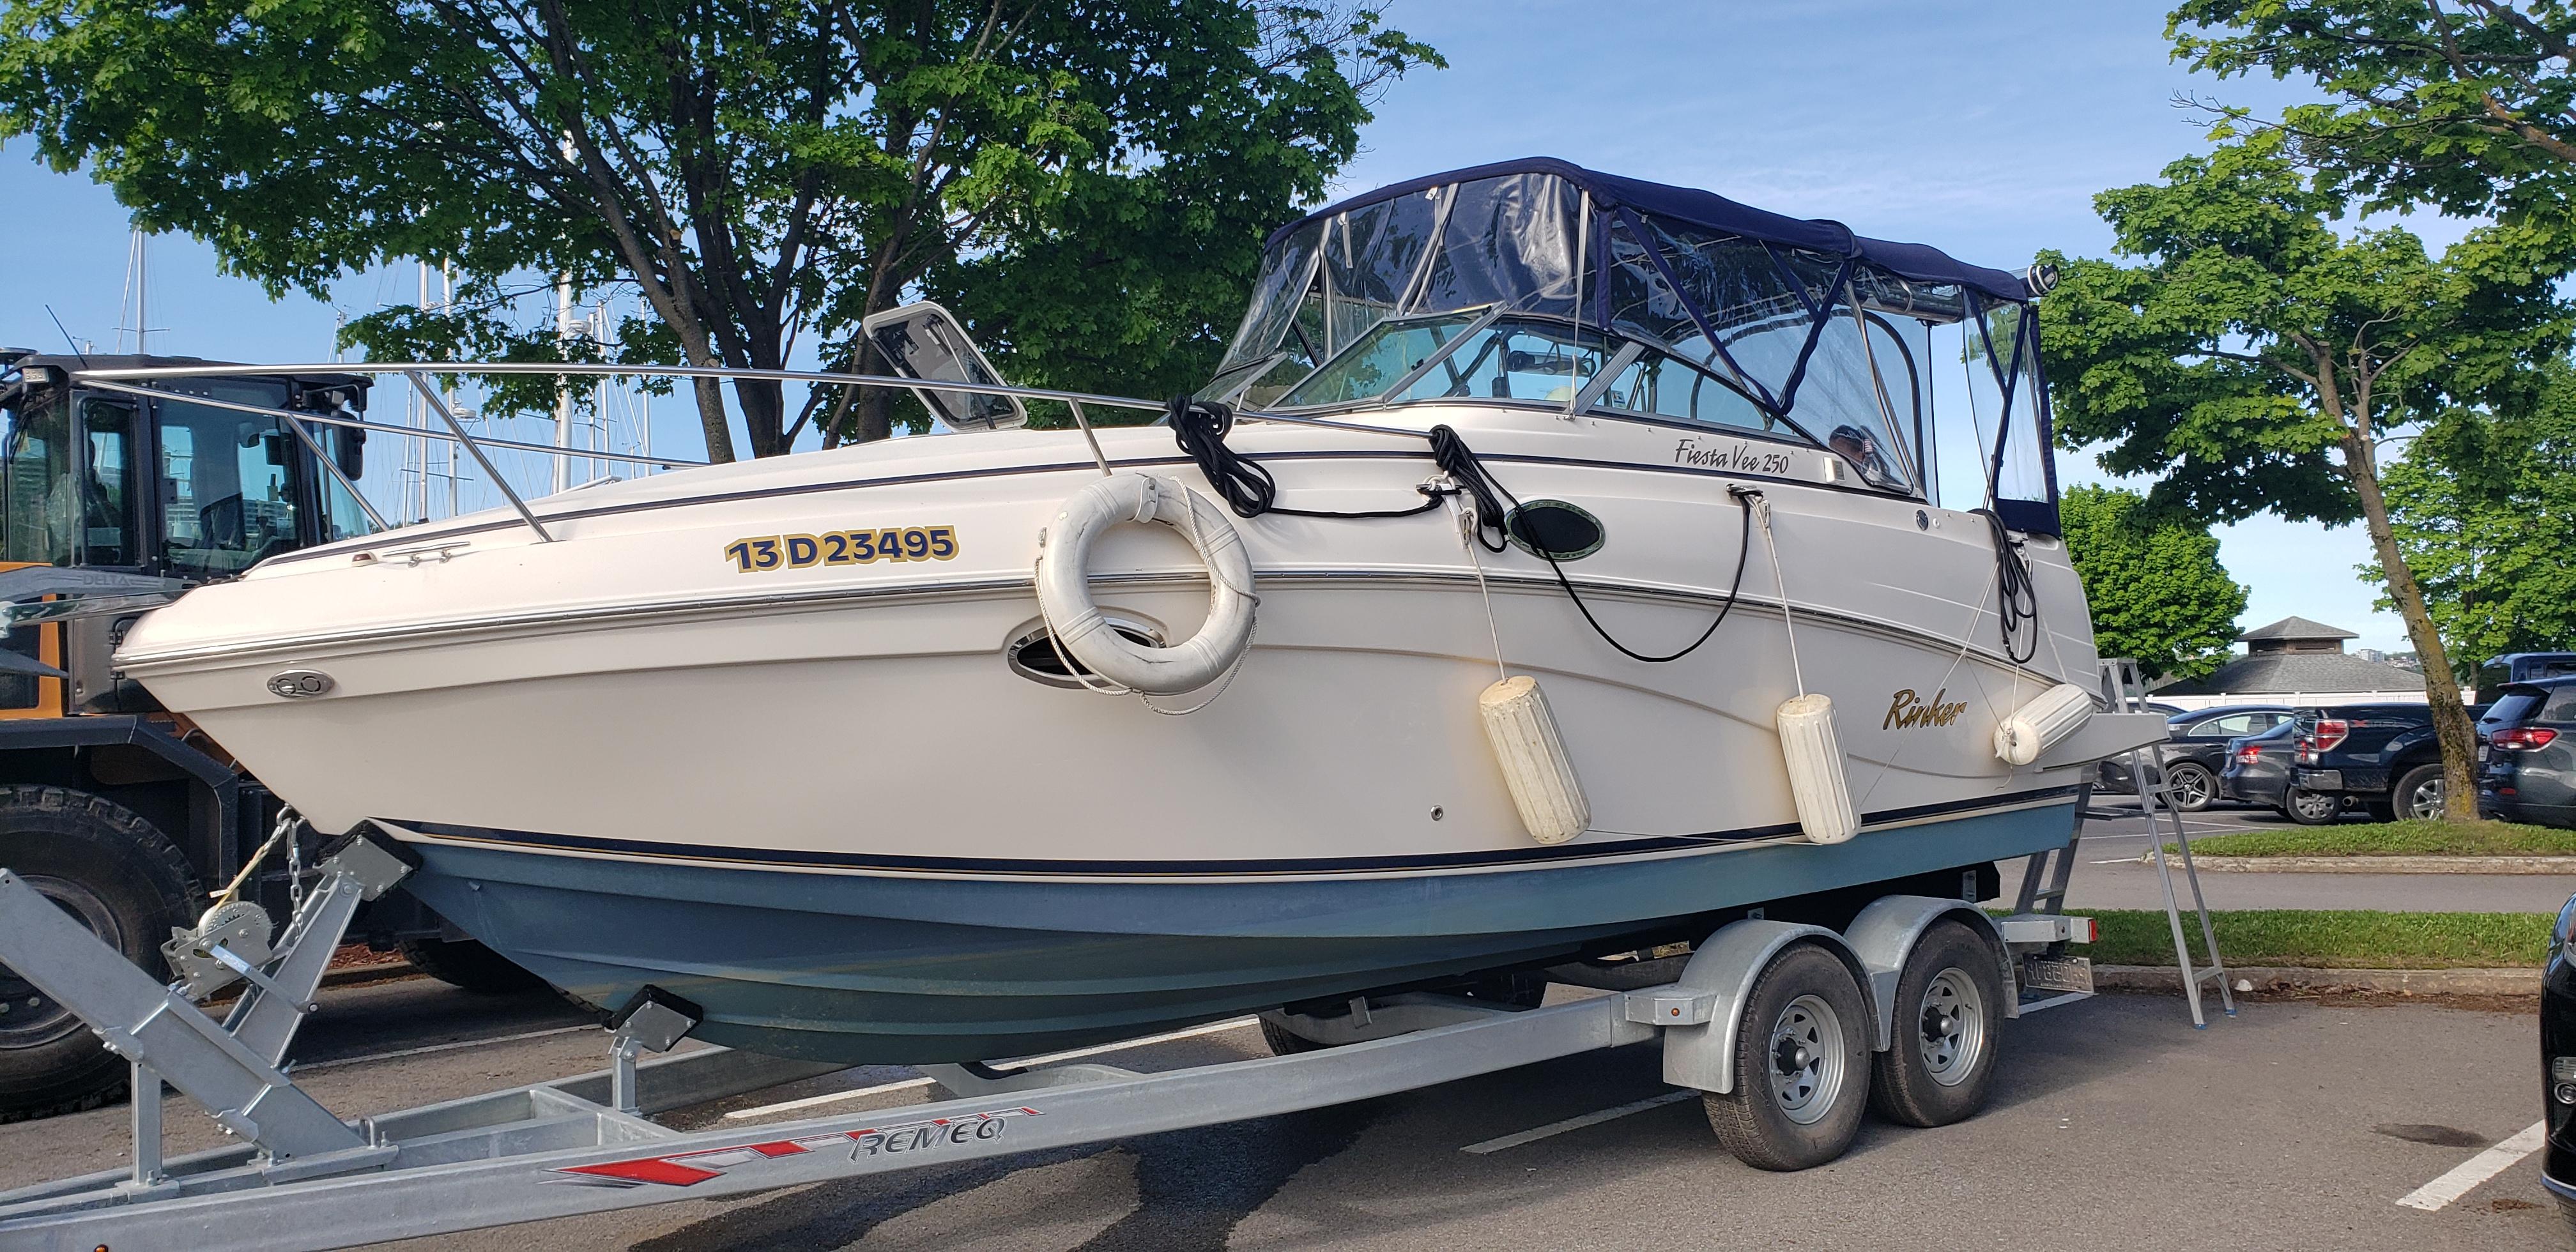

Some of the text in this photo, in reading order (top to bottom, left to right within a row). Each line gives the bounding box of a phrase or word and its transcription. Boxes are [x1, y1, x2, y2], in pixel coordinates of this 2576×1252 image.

[1675, 439, 1789, 474] Fiesta Vee 250
[84, 574, 131, 586] DELTA
[1882, 688, 1968, 730] Rinker
[847, 1116, 1008, 1164] REMEQ
